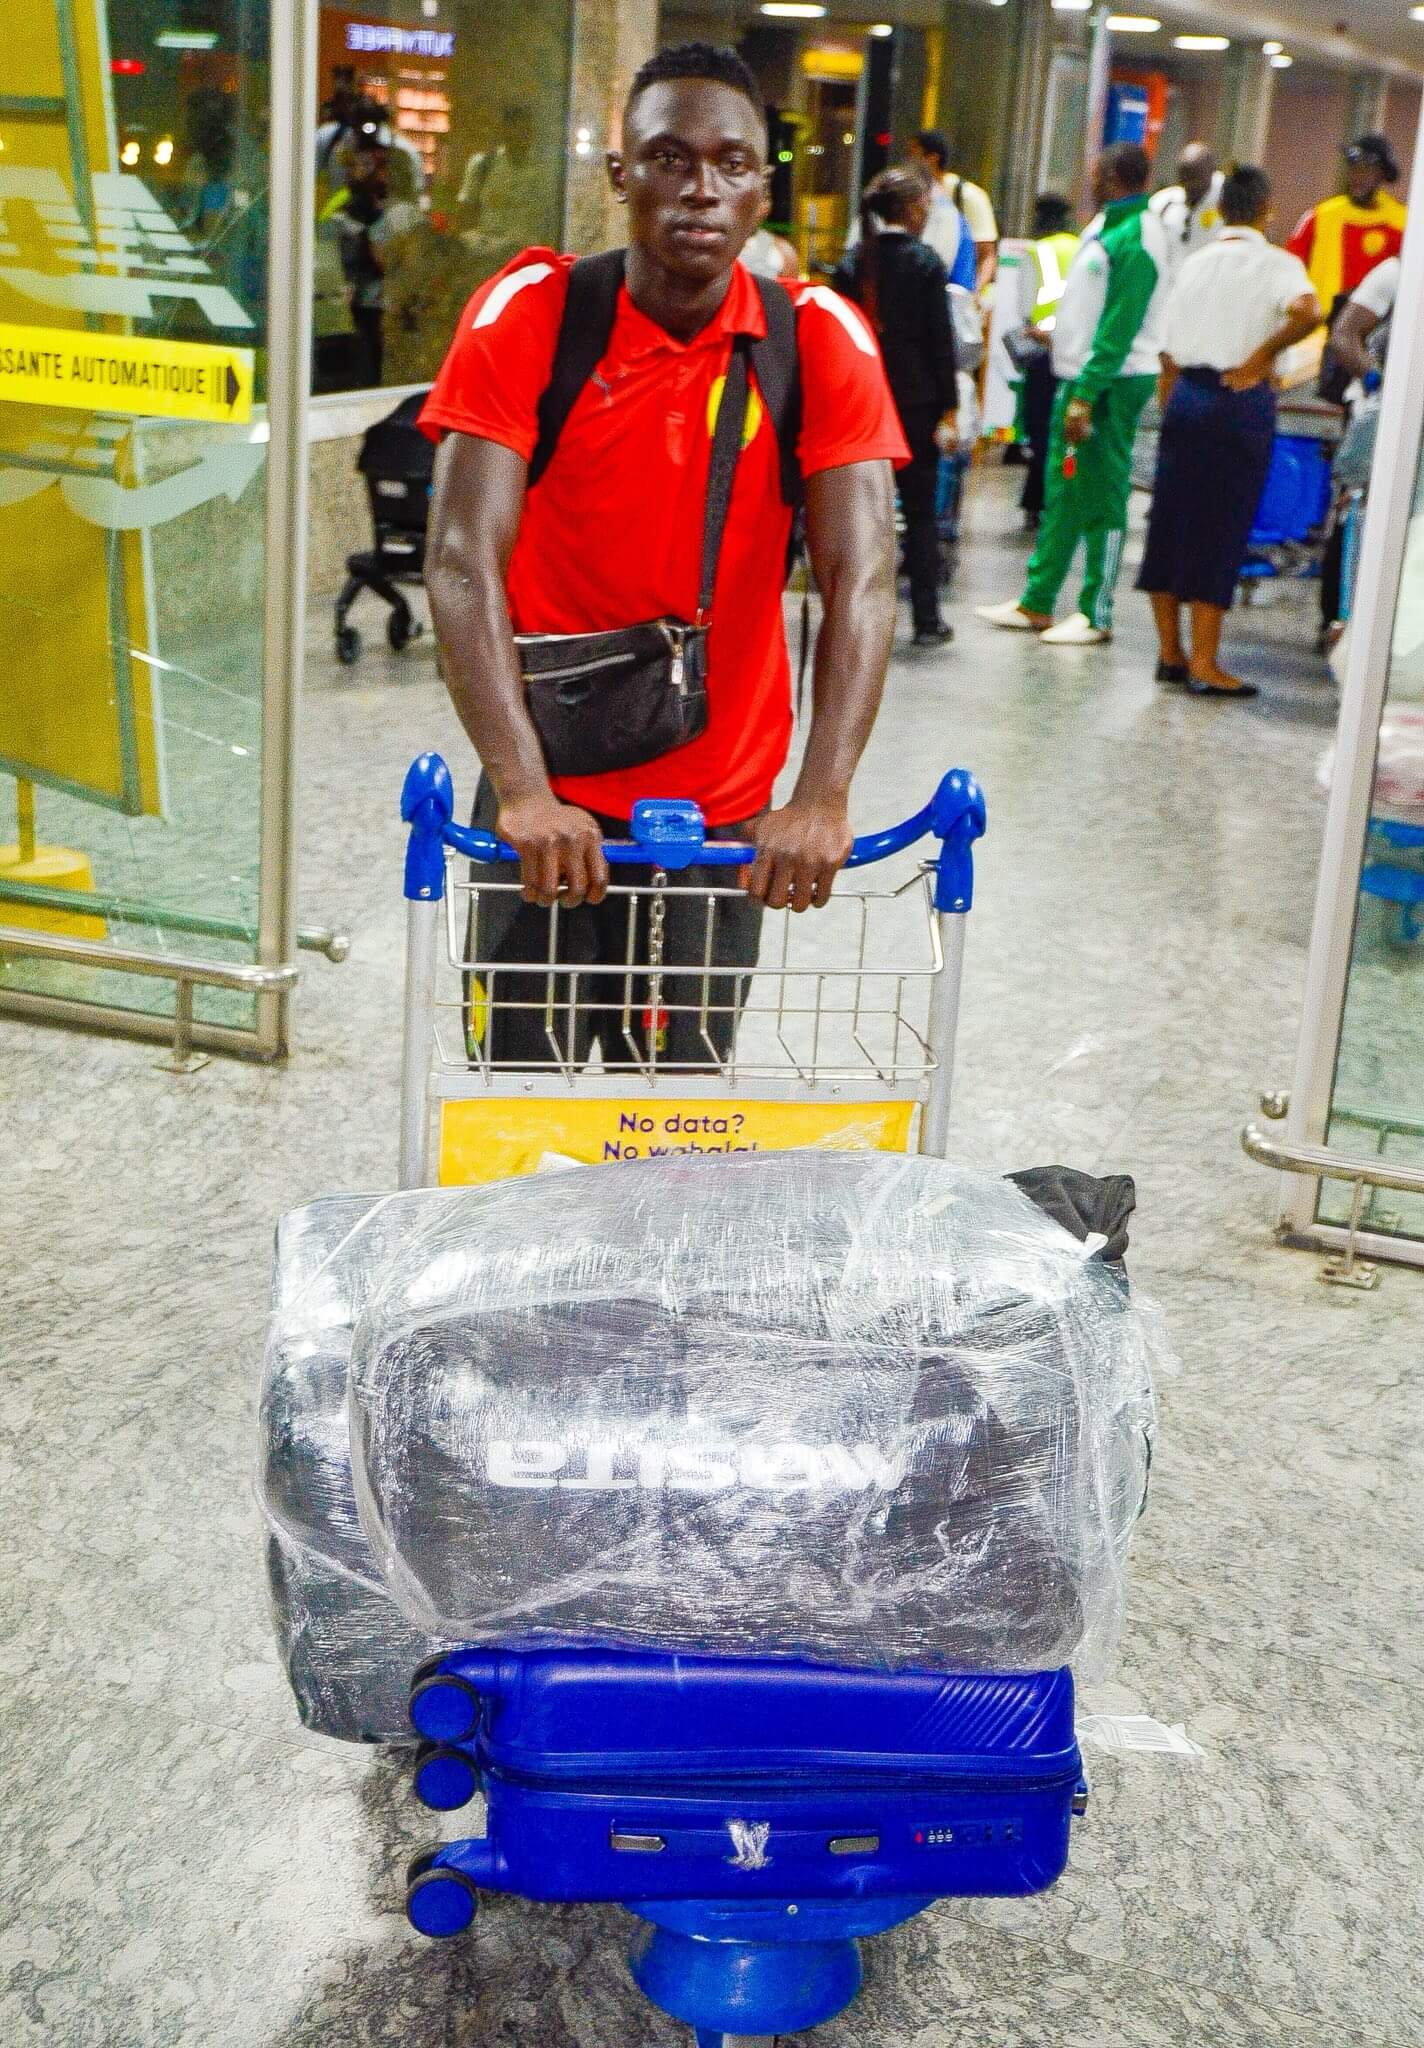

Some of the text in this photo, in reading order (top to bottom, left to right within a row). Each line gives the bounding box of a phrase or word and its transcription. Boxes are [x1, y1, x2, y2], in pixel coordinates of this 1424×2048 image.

[0, 348, 206, 394] SANTE AUTOMATIQUE
[620, 1112, 745, 1134] No data?
[604, 1140, 757, 1160] No wahl
